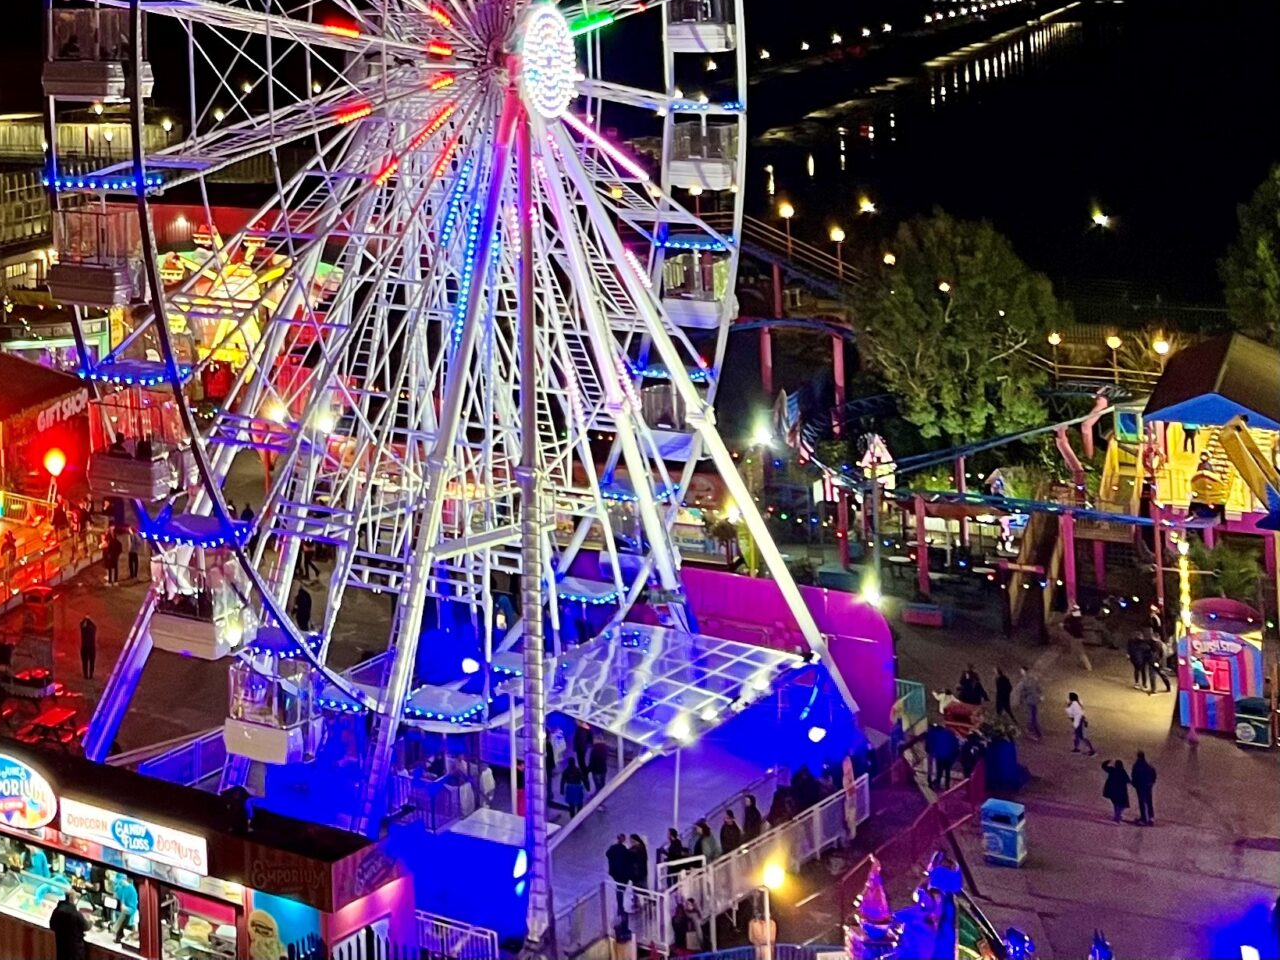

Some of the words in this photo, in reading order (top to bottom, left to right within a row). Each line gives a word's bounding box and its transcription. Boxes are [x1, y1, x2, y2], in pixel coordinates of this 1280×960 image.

[37, 401, 61, 432] GIFT
[62, 388, 89, 421] SHOP
[67, 814, 108, 832] POPCORN
[114, 821, 147, 839] CANDY
[121, 836, 150, 851] FLOSS
[251, 859, 325, 889] EMPORIUM
